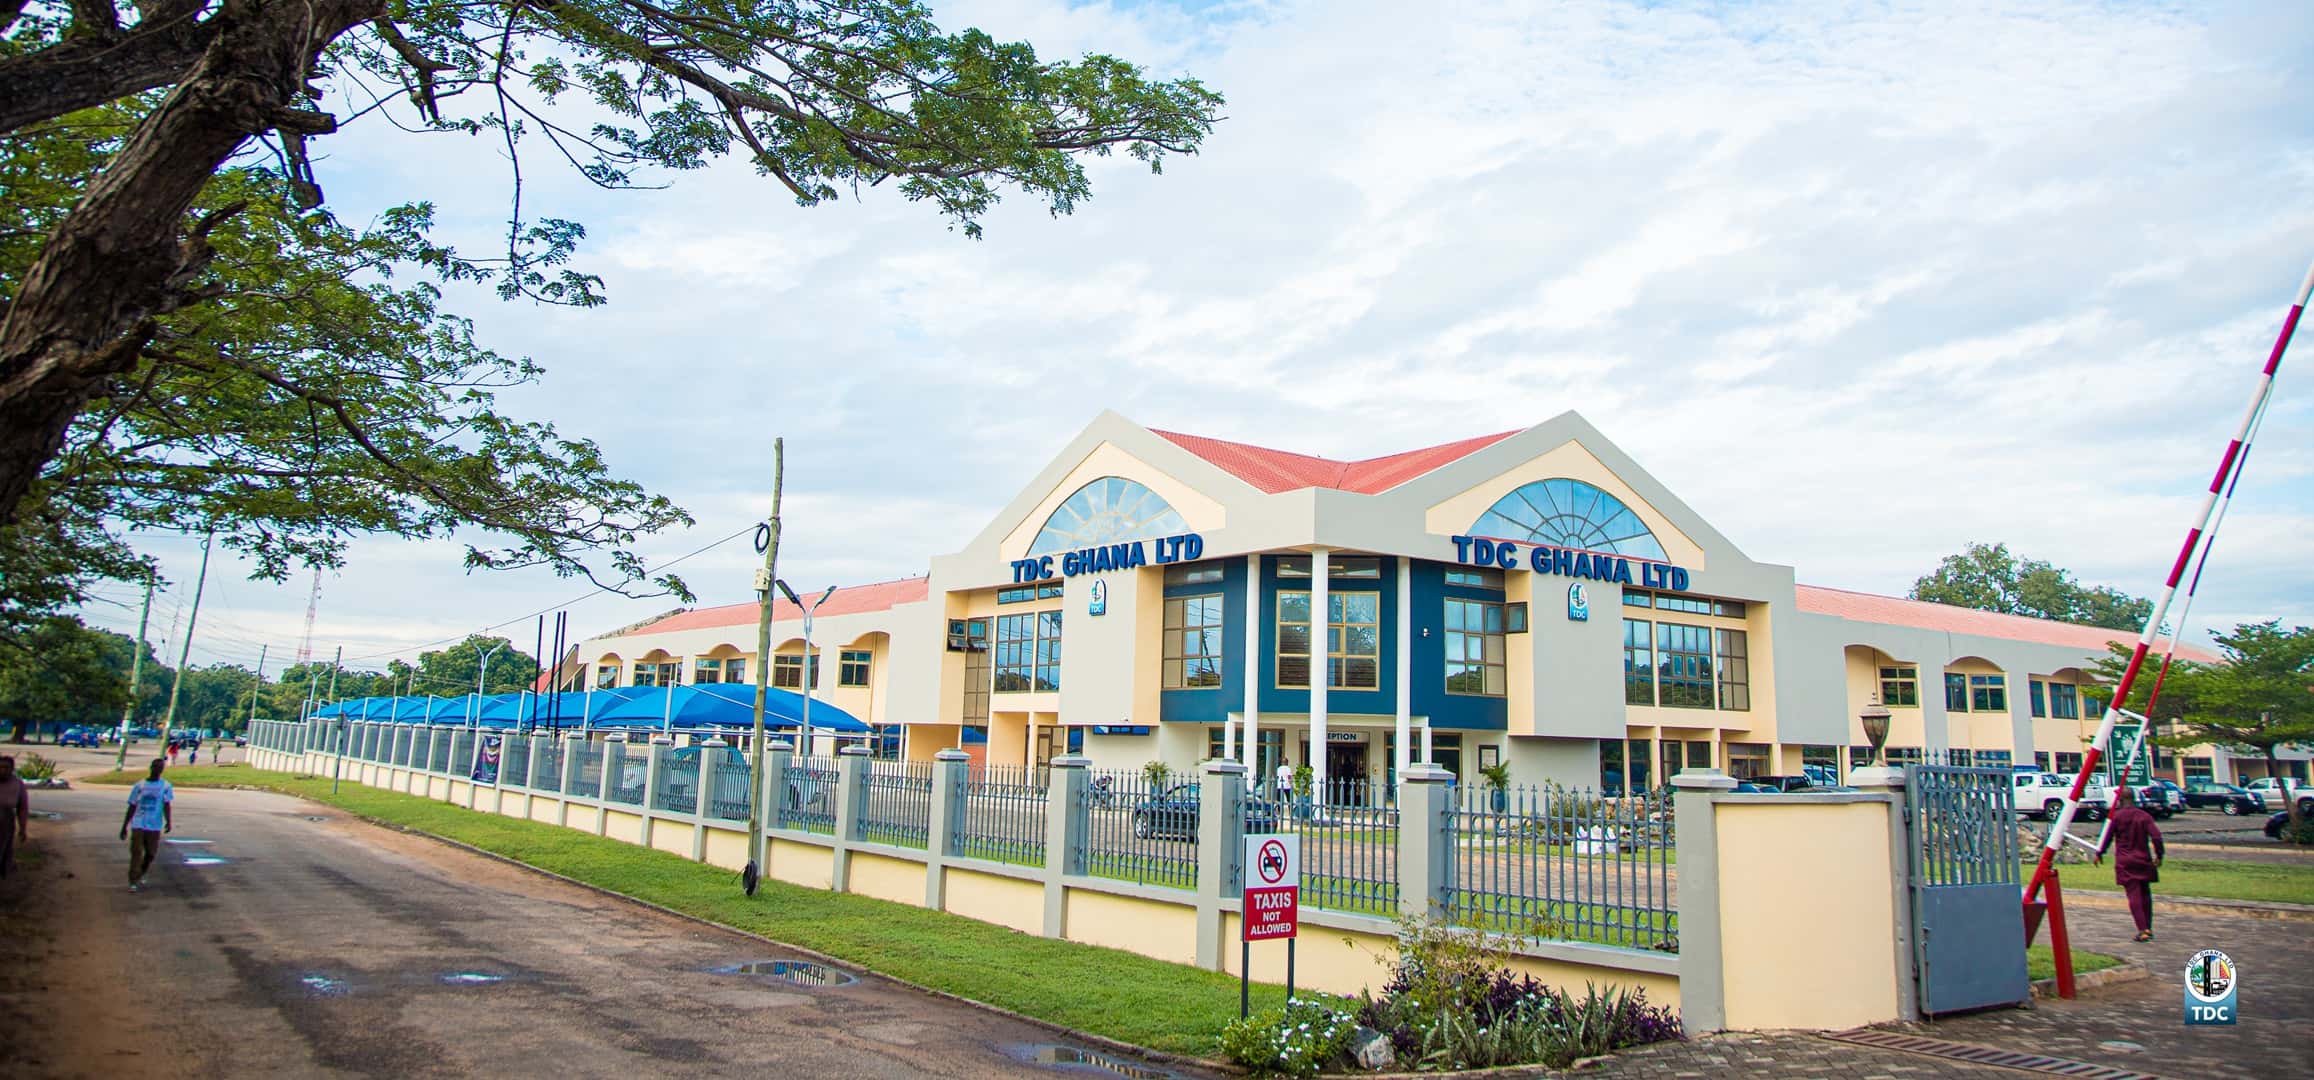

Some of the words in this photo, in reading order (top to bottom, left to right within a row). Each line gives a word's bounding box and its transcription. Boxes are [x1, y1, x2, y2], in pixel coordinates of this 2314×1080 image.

[1011, 555, 1054, 583] TDC
[1062, 541, 1146, 577] GHANA
[1155, 533, 1204, 564] LTD
[1452, 535, 1518, 569] TDC
[1531, 547, 1633, 585] GHANA
[1642, 562, 1689, 591] LTD
[1573, 609, 1586, 619] TDC
[1327, 732, 1357, 741] EPTION
[1254, 892, 1292, 909] TAXIS
[1263, 911, 1281, 922] NOT
[1250, 922, 1292, 936] ALLOWED
